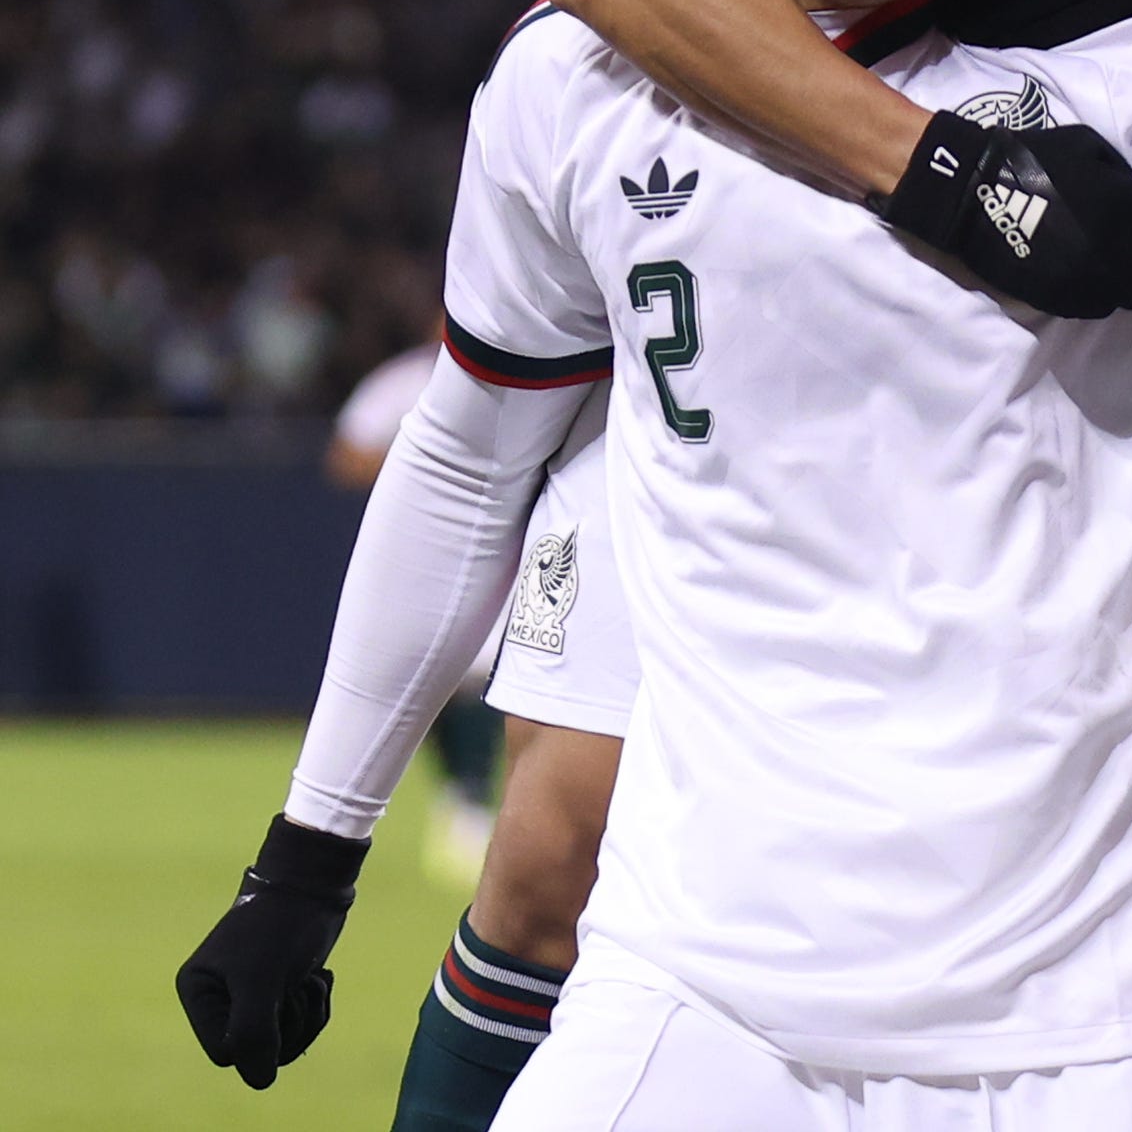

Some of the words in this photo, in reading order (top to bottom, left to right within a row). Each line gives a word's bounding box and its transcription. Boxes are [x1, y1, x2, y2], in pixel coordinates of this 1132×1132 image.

[929, 146, 960, 178] 17
[976, 183, 1041, 258] adidas
[626, 260, 715, 444] 2
